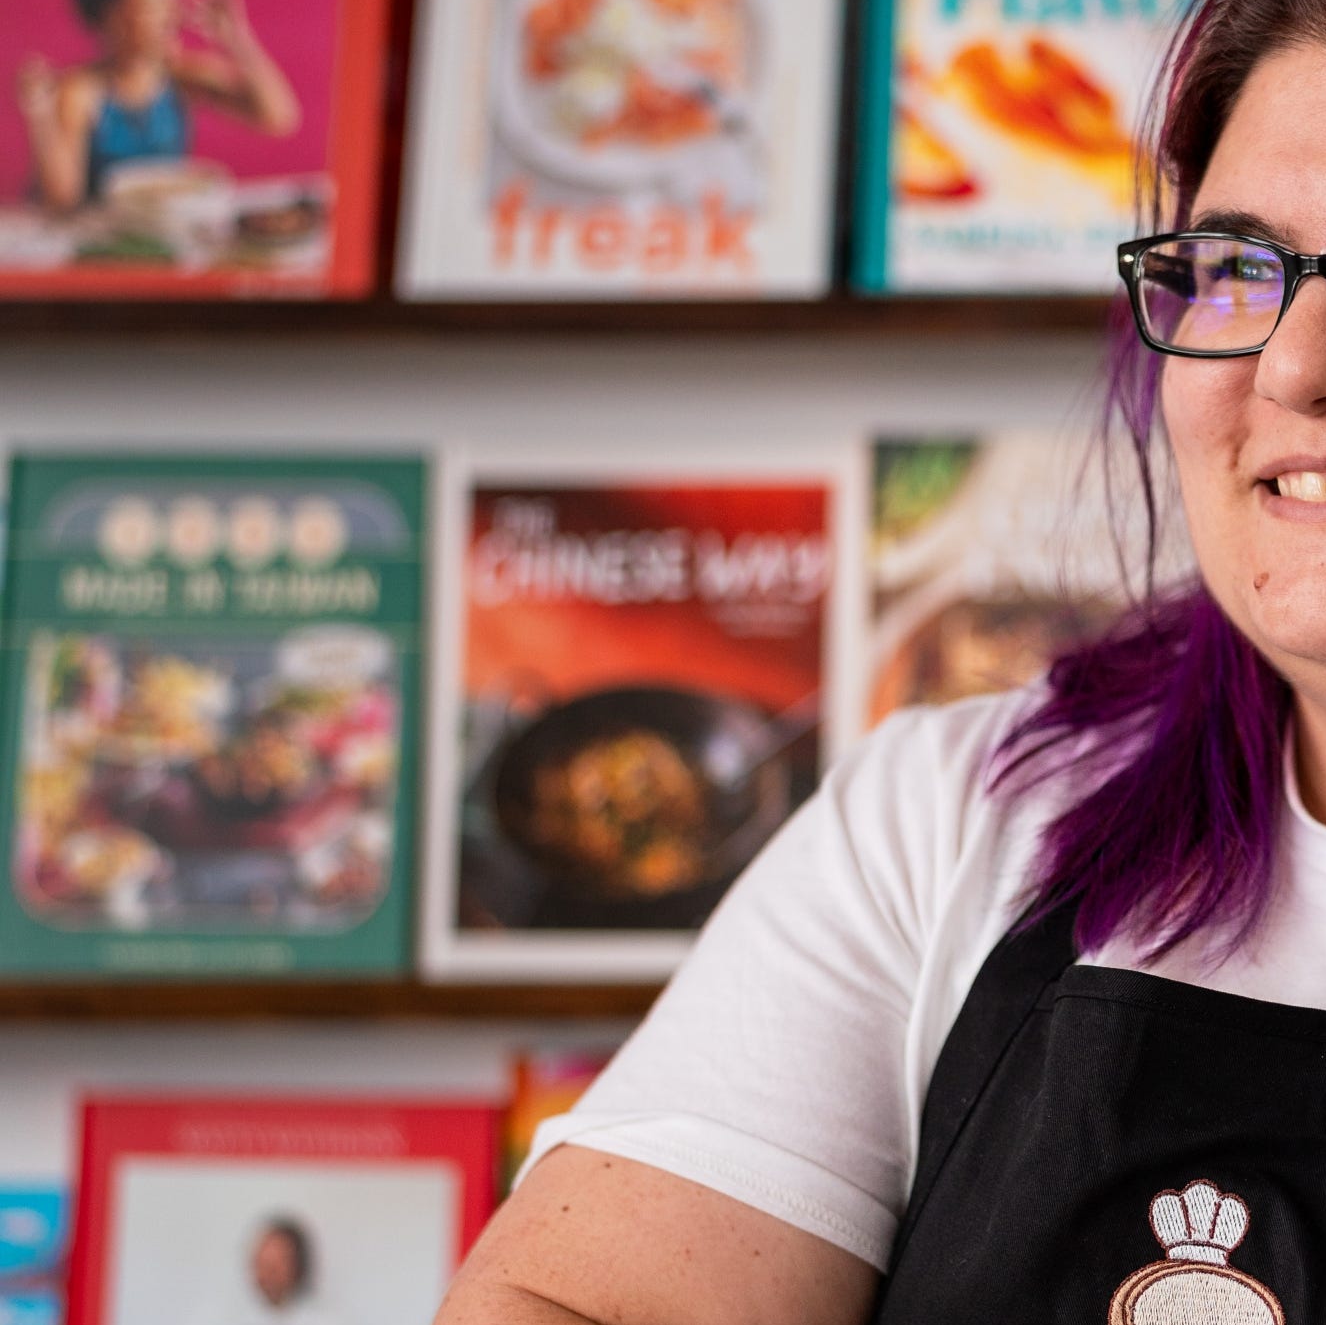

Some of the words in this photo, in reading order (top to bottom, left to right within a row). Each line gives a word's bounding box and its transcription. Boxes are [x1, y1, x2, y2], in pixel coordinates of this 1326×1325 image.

[490, 185, 750, 269] freak
[473, 537, 695, 597] CHINESE
[700, 537, 824, 597] WAY
